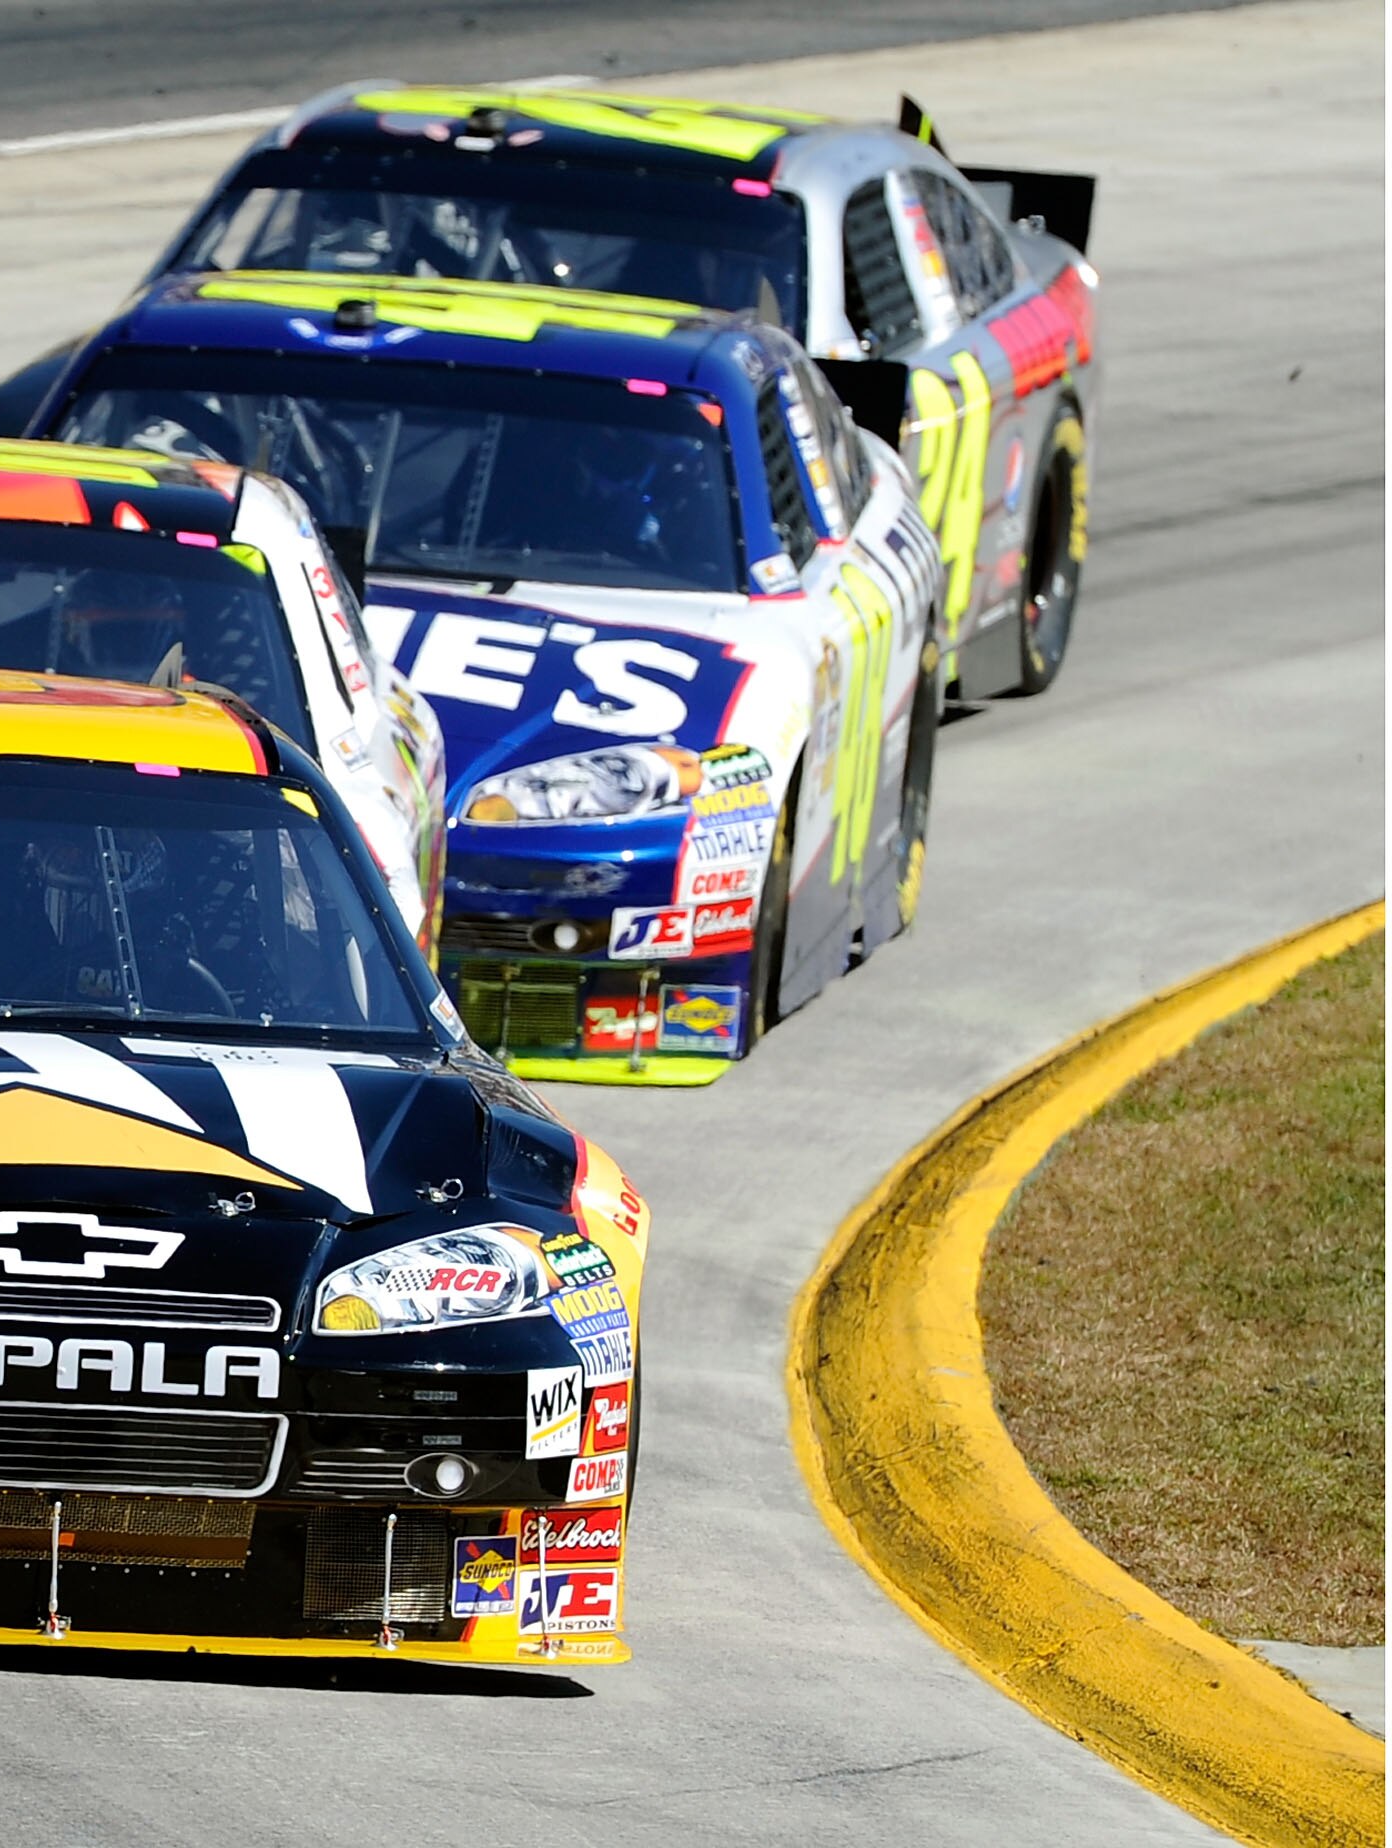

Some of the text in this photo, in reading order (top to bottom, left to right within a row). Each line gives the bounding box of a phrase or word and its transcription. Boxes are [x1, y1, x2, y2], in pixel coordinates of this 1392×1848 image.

[692, 781, 769, 816] MOOG
[692, 823, 767, 860] MAHLE
[692, 869, 746, 895] COMP
[614, 911, 688, 952] JE
[426, 1268, 501, 1293] RCR
[563, 1264, 613, 1287] BELTS
[550, 1282, 624, 1326] MOOG
[576, 1331, 631, 1376] MAHLE
[531, 1371, 577, 1427] WIX
[530, 1422, 577, 1455] FILTERS
[574, 1459, 616, 1492] COMP
[463, 1562, 513, 1581] SUNOCO
[521, 1572, 614, 1629] JE
